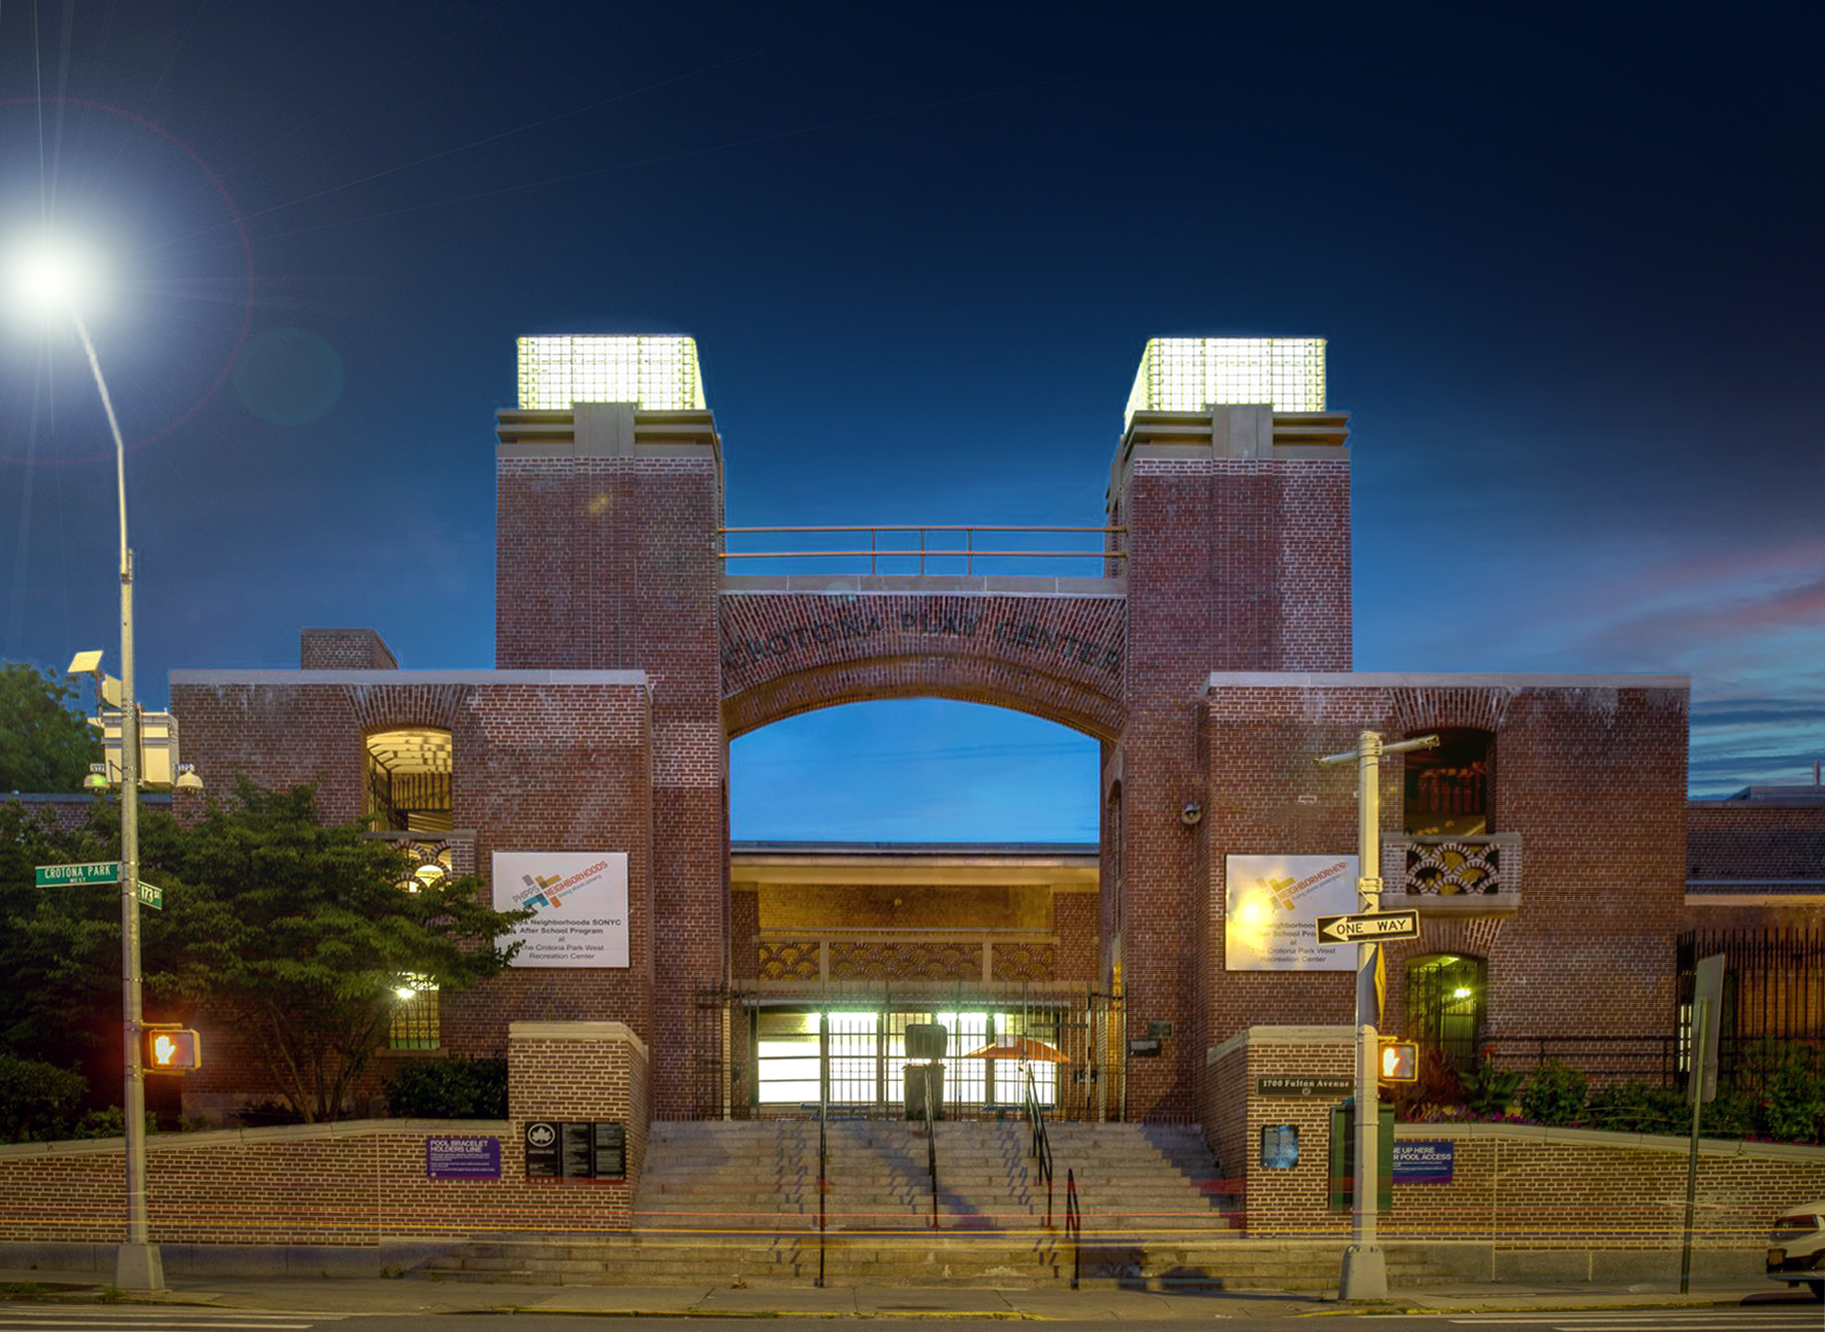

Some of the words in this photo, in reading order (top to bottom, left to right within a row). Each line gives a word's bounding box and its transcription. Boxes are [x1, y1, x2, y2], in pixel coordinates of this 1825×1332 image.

[723, 615, 882, 671] CROTONA
[901, 612, 981, 637] PLAY
[998, 620, 1120, 673] CENTER
[44, 866, 84, 879] CROTONA
[87, 864, 112, 877] PARK
[512, 885, 541, 904] PHIPPS
[544, 860, 609, 898] NEIGHBORHOODS
[141, 885, 154, 904] 173
[530, 919, 590, 928] Neighborhoods
[1336, 922, 1364, 935] ONE
[1377, 919, 1407, 932] WAY
[569, 927, 604, 936] Program
[1273, 928, 1301, 937] School
[535, 943, 565, 951] Crotona
[566, 943, 583, 951] Park
[585, 943, 605, 951] West
[1268, 946, 1297, 955] Crotona
[1298, 946, 1315, 955] Park
[1317, 946, 1336, 954] West
[529, 952, 568, 960] Recreation
[570, 952, 596, 960] Center
[1259, 955, 1300, 964] Recreation
[1302, 955, 1327, 963] Center
[1284, 1079, 1315, 1088] Fulton
[1317, 1080, 1351, 1088] Avenue
